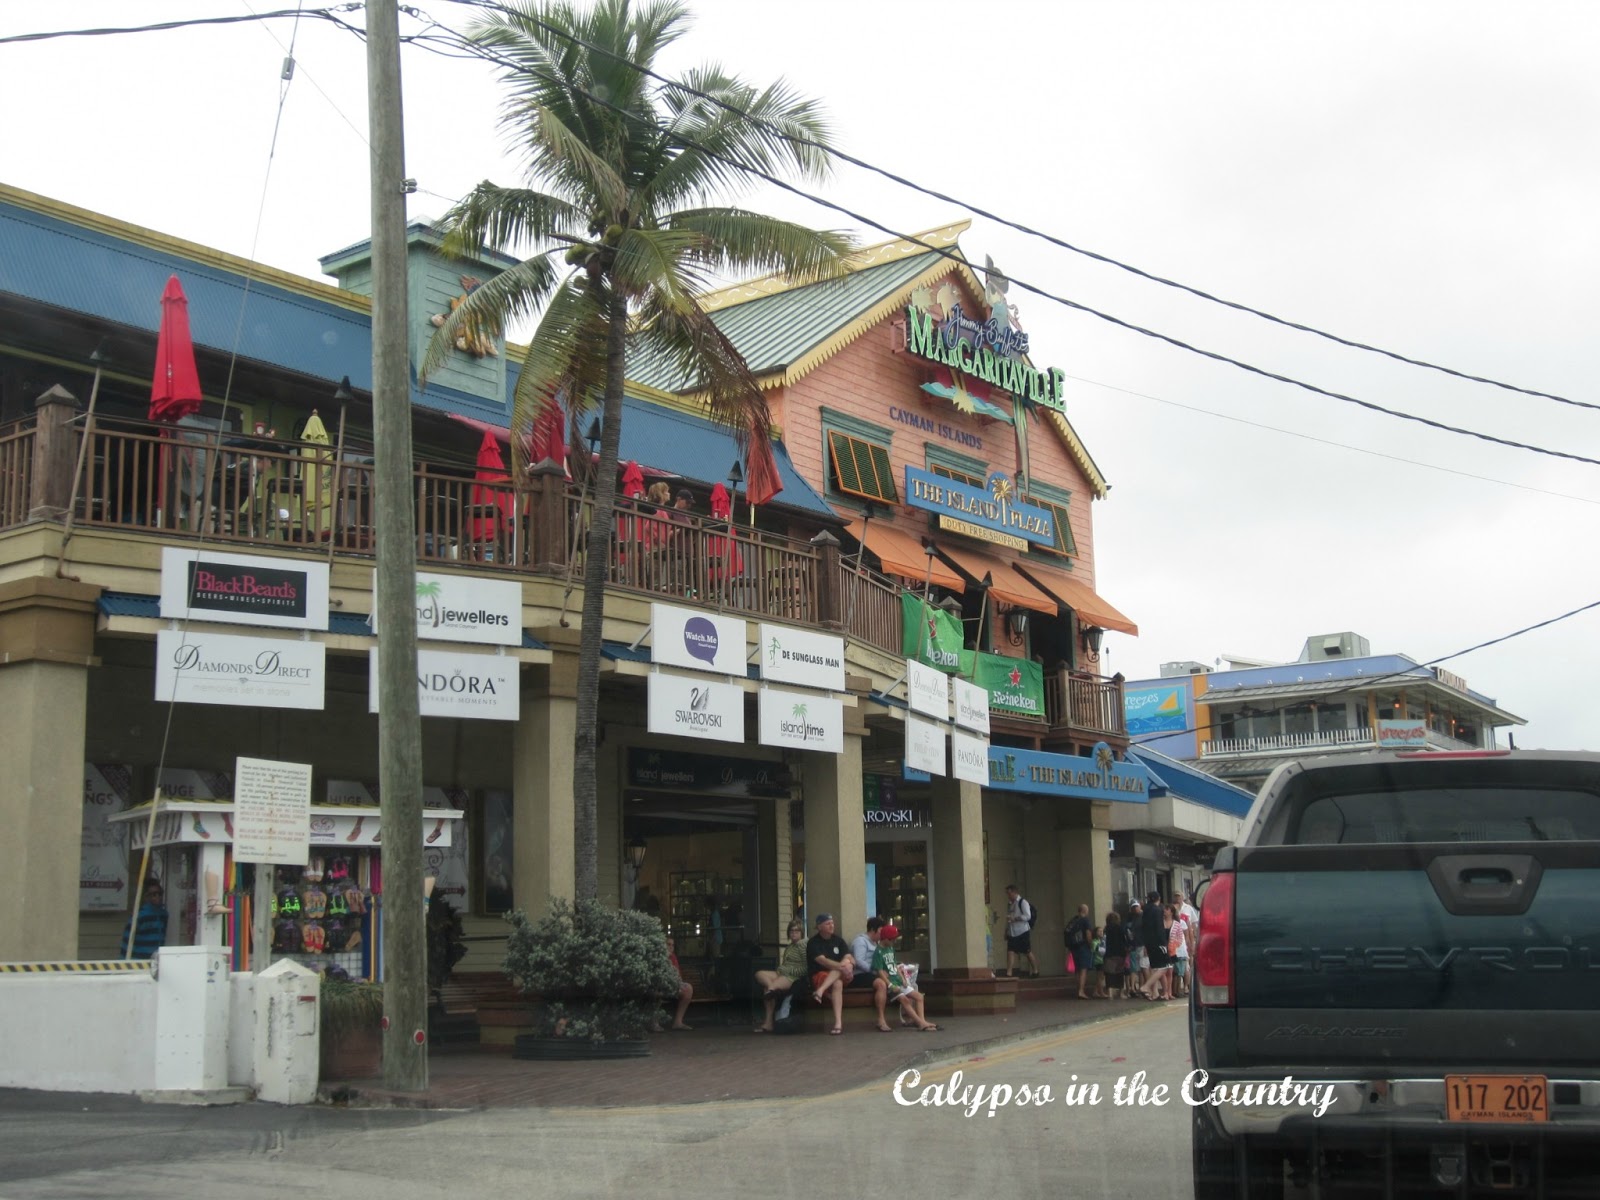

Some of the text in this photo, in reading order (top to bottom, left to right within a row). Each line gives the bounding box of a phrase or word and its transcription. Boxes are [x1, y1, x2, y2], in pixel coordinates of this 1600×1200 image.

[945, 303, 985, 349] Jimmy
[908, 305, 1067, 413] MARGARITAVILLE
[889, 406, 982, 450] CAYMAN ISLANDS
[911, 478, 1051, 537] THE ISLAND PLAZA
[946, 518, 1024, 549] DUTY FREE SHOPPING
[197, 571, 296, 599] BlackBeard's
[441, 607, 509, 626] jewellers
[782, 650, 839, 668] DE SUNGLASS MAN
[418, 673, 496, 695] NDORA
[993, 690, 1037, 711] Heineken
[1125, 693, 1159, 706] reezes
[675, 710, 722, 728] SWAROVSKI
[781, 720, 803, 734] island
[807, 722, 824, 737] time
[958, 749, 984, 768] PANDORA
[1029, 765, 1054, 784] THE
[1057, 768, 1102, 788] ISLAND
[1110, 775, 1145, 793] PLAZA
[1263, 947, 1600, 972] CHEVROL
[1452, 1084, 1544, 1111] 117 202
